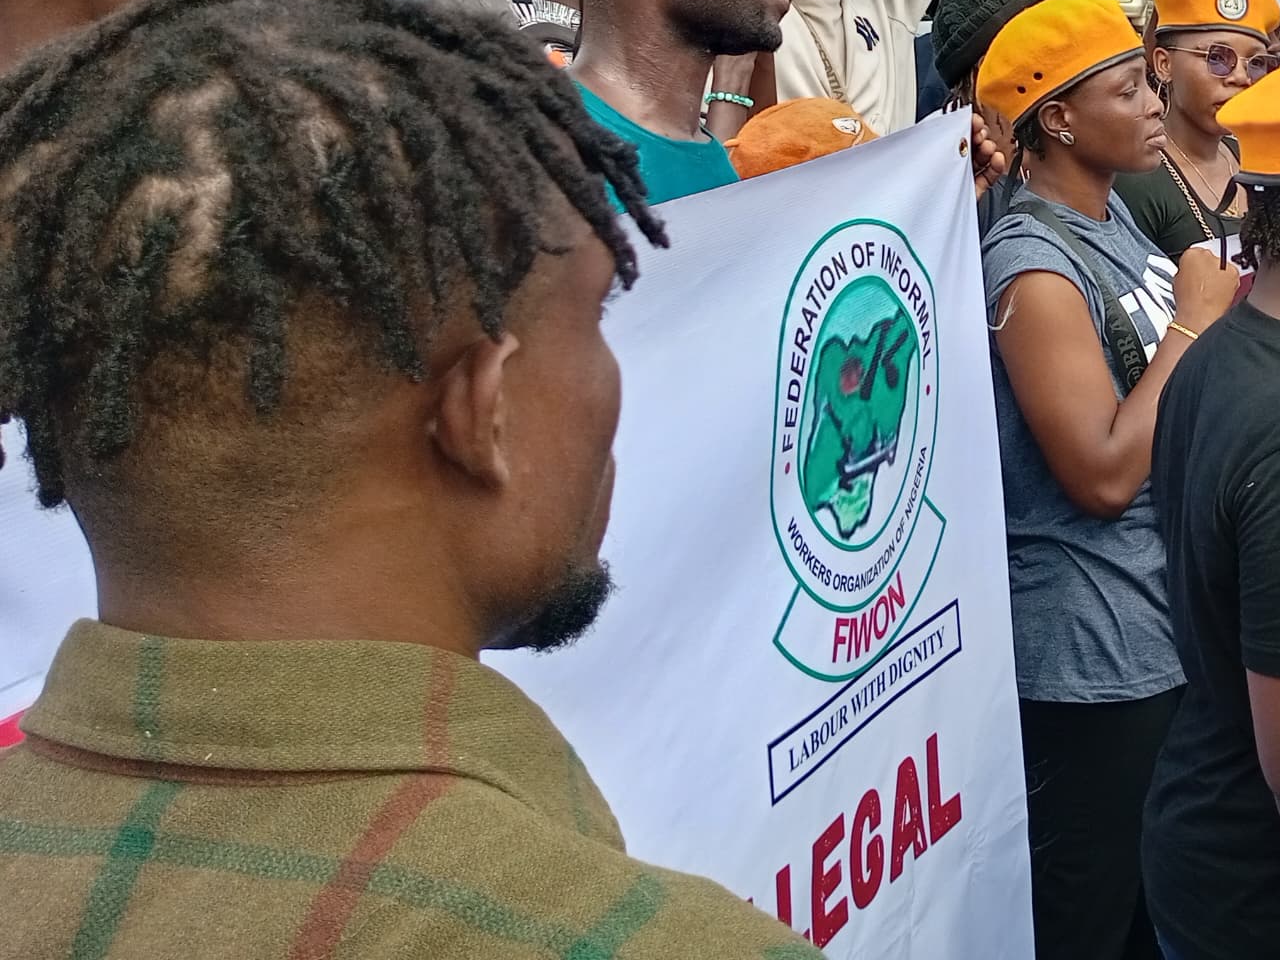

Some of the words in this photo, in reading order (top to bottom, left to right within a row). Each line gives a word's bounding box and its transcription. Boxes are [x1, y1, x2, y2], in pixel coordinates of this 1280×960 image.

[782, 251, 849, 452] FEDERATION
[851, 241, 875, 268] OF
[881, 244, 931, 370] INFORMAL
[787, 517, 831, 586] WORKERS
[832, 542, 896, 593] ORGANIZATION
[894, 518, 908, 543] OF
[905, 446, 928, 522] NIGERIA
[832, 570, 906, 664] FWON
[788, 705, 849, 773] LABOUR
[851, 671, 886, 719] WITH
[888, 625, 945, 687] DIGNITY
[746, 732, 962, 950] LEGAL
